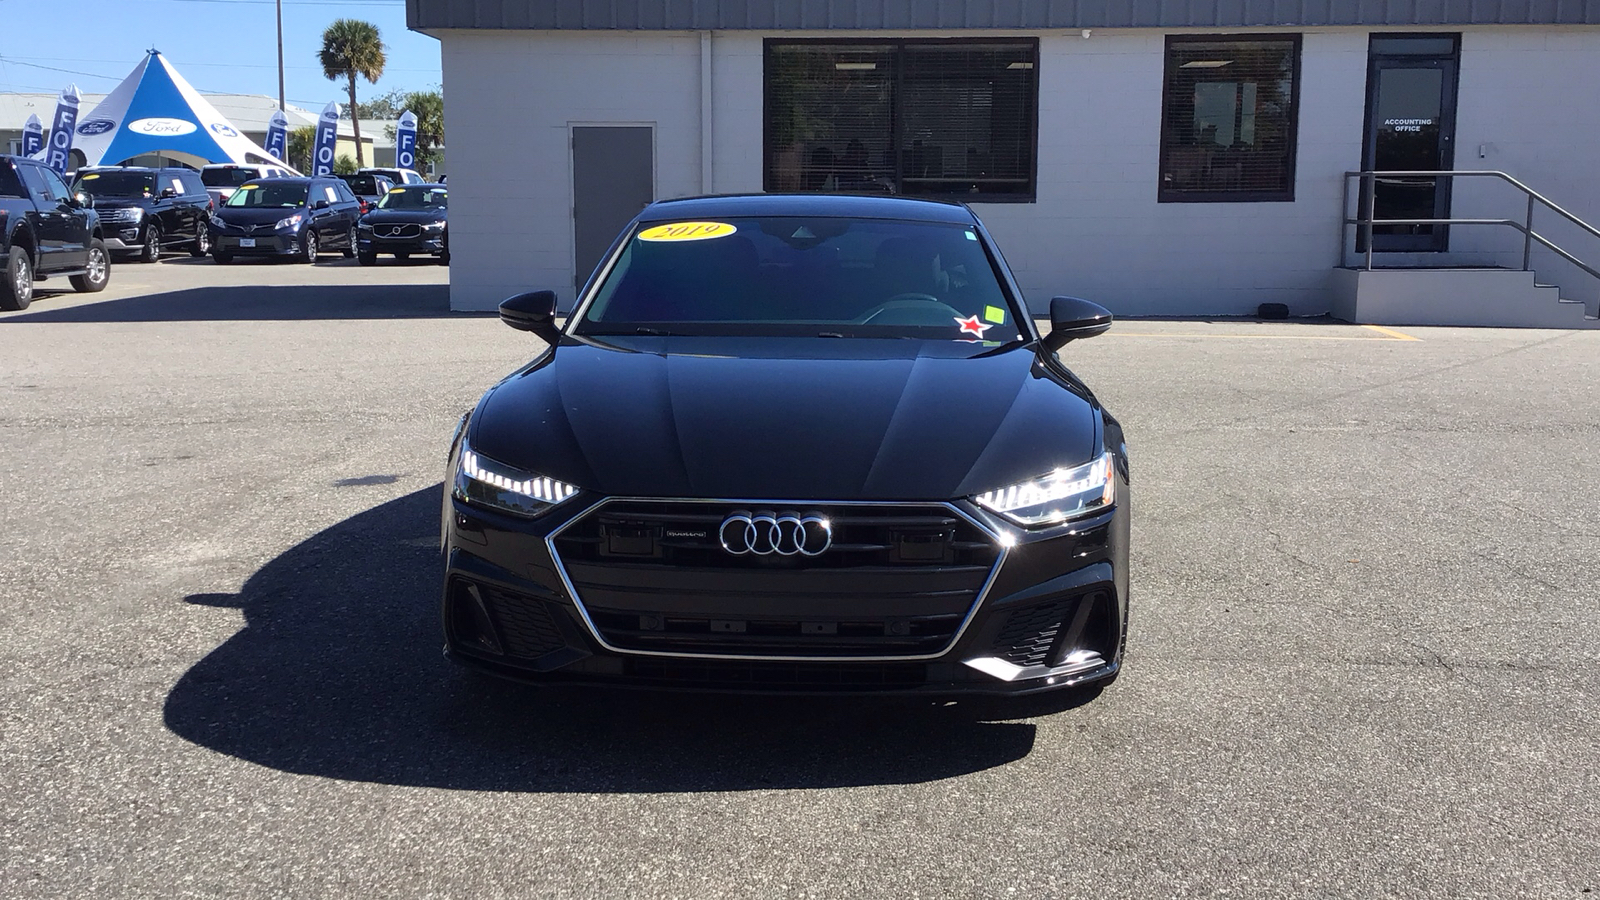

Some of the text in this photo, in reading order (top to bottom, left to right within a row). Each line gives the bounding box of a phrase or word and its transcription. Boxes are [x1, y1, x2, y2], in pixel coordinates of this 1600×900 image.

[81, 122, 109, 133] Ford
[143, 121, 181, 132] Ford
[652, 224, 721, 239] 2019
